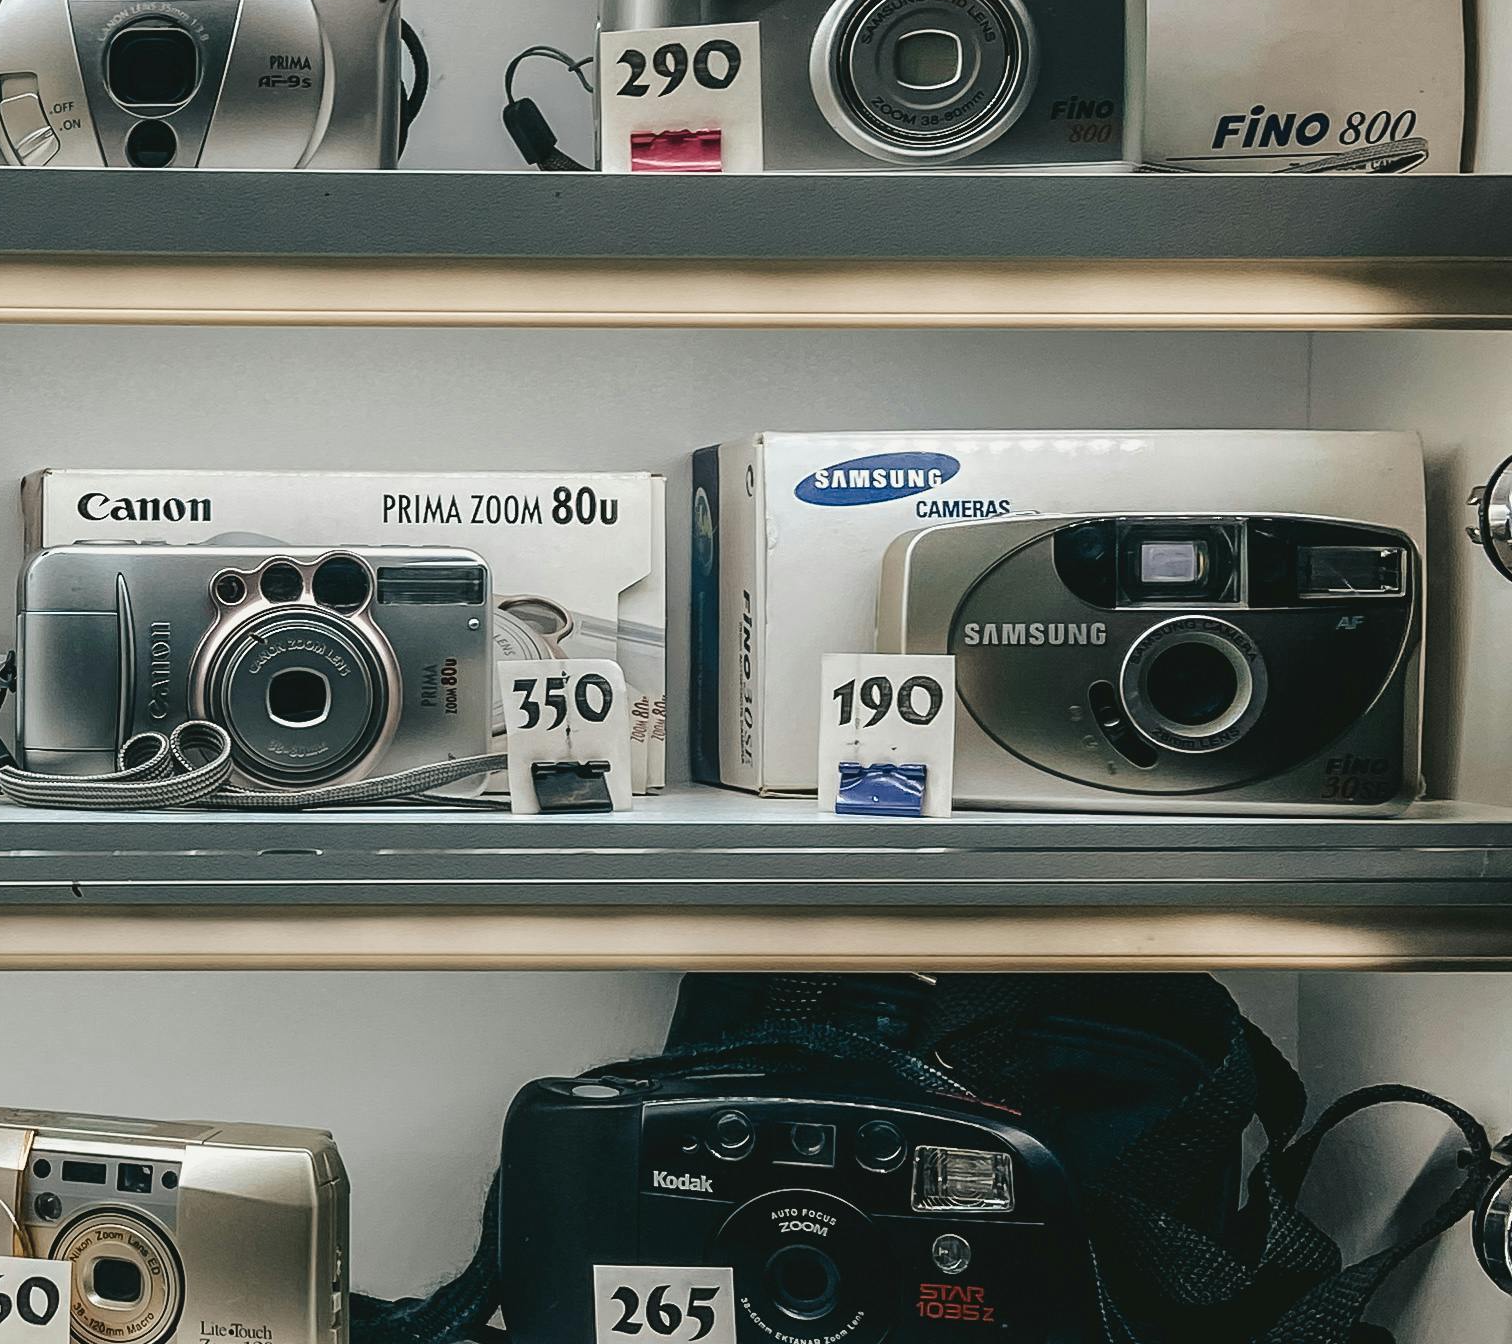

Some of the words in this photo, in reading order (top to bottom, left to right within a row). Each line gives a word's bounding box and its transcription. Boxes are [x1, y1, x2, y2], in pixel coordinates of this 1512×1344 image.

[966, 5, 998, 45] LENS
[269, 55, 312, 71] PRIMA
[616, 38, 742, 98] 290
[870, 95, 917, 126] ZOOM
[1338, 109, 1418, 146] 800
[814, 468, 943, 489] SAMSUNG
[76, 492, 213, 523] Canon
[383, 493, 464, 525] PRIMA
[469, 494, 545, 526] ZOOM
[550, 486, 620, 526] 80u
[915, 500, 1011, 518] CAMERAS
[964, 622, 1107, 647] SAMSUNG
[1335, 615, 1367, 631] AF
[420, 662, 439, 708] PRIMA
[445, 686, 459, 716] ZOOM
[512, 673, 614, 732] 350
[833, 675, 944, 729] 190
[652, 1169, 714, 1194] Kodak
[770, 1208, 798, 1221] AUTO
[801, 1208, 837, 1226] FOCUS
[778, 1220, 829, 1237] ZOOM
[69, 1237, 93, 1263] Nikon
[95, 1230, 124, 1241] Zoom
[148, 1257, 161, 1275] ED
[919, 1283, 986, 1303] STAR
[126, 1312, 155, 1335] Macro
[610, 1284, 720, 1341] 265
